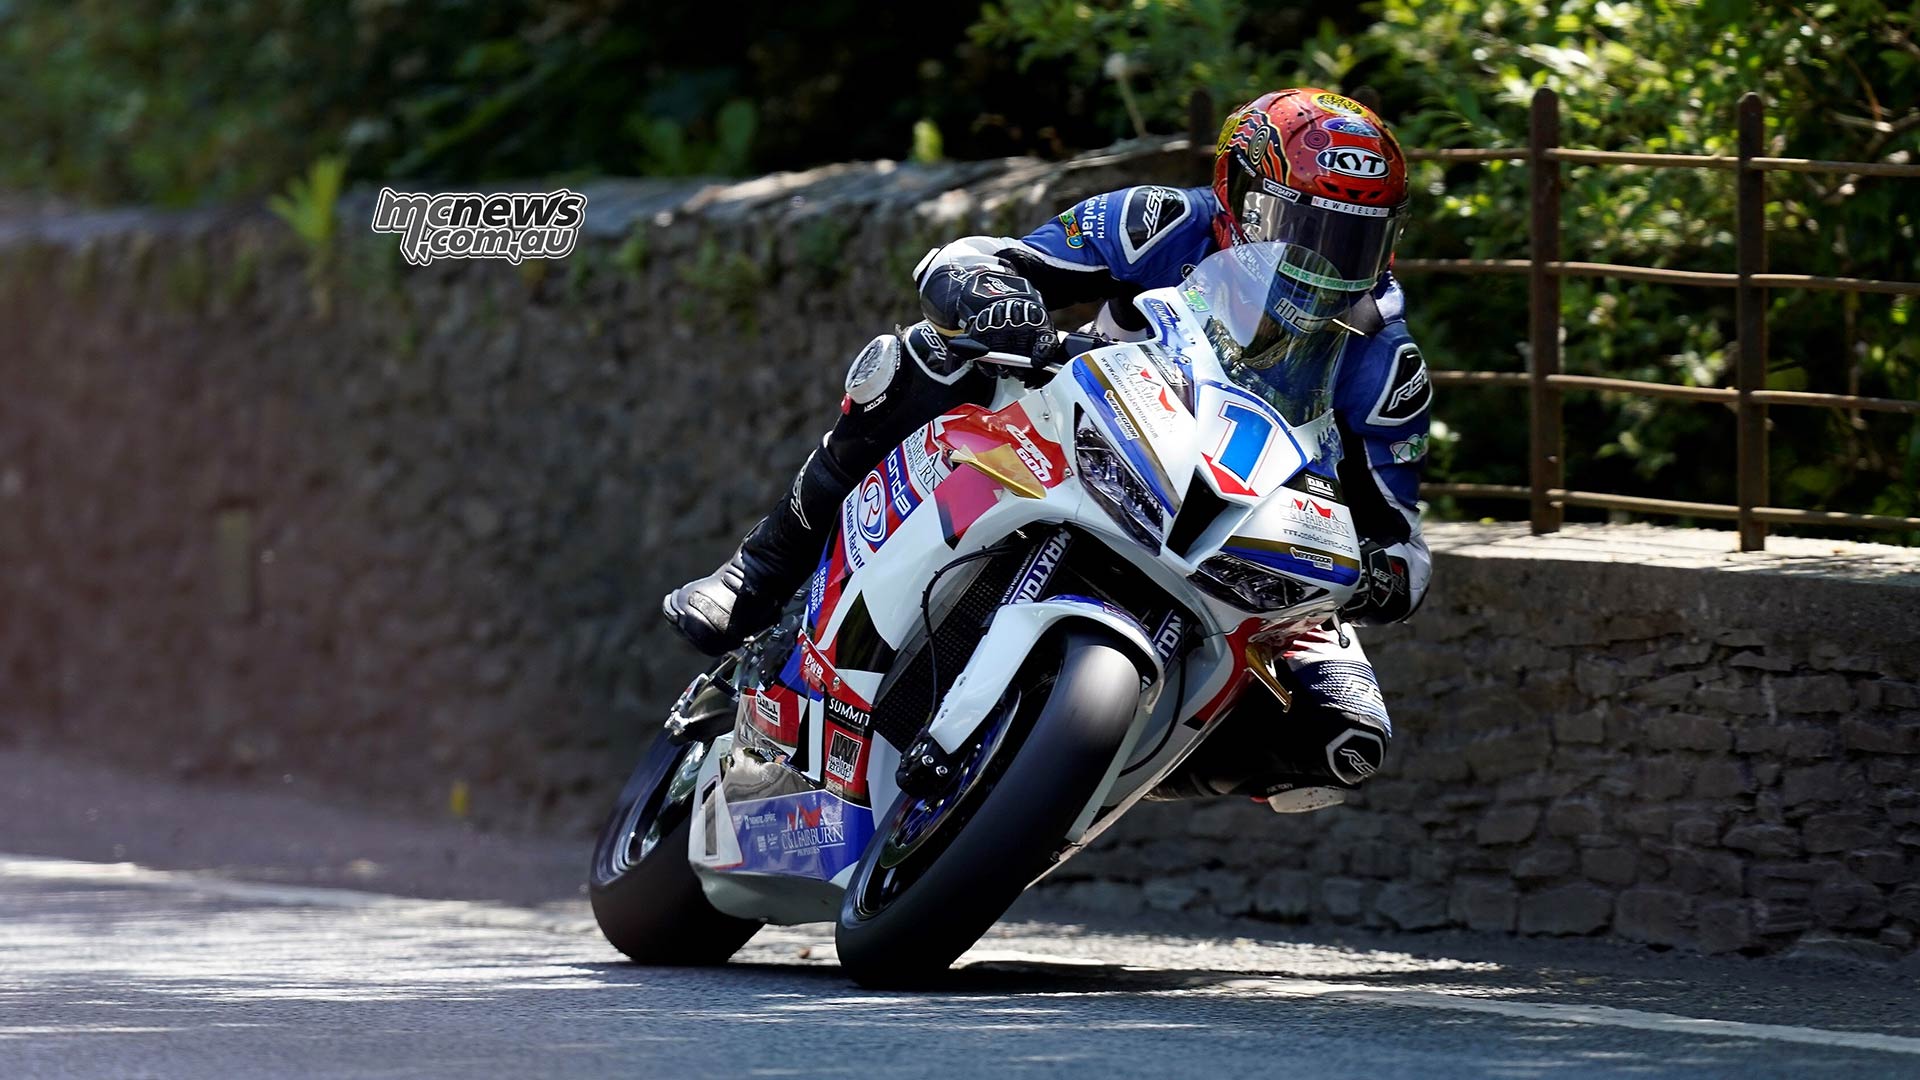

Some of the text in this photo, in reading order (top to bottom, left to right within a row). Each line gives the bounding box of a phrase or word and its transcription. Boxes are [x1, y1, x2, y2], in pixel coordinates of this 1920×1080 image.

[1327, 151, 1384, 174] KYT
[1142, 186, 1165, 238] RST
[1313, 198, 1378, 215] NEWFIELD
[1097, 211, 1106, 239] WITH
[1281, 263, 1311, 281] CHASE
[1218, 404, 1273, 483] 1
[1016, 447, 1051, 481] 600
[1015, 527, 1072, 602] MAXTON
[828, 698, 870, 727] SUMMIT
[1340, 748, 1377, 777] RS
[797, 825, 844, 848] FAIRBURN
